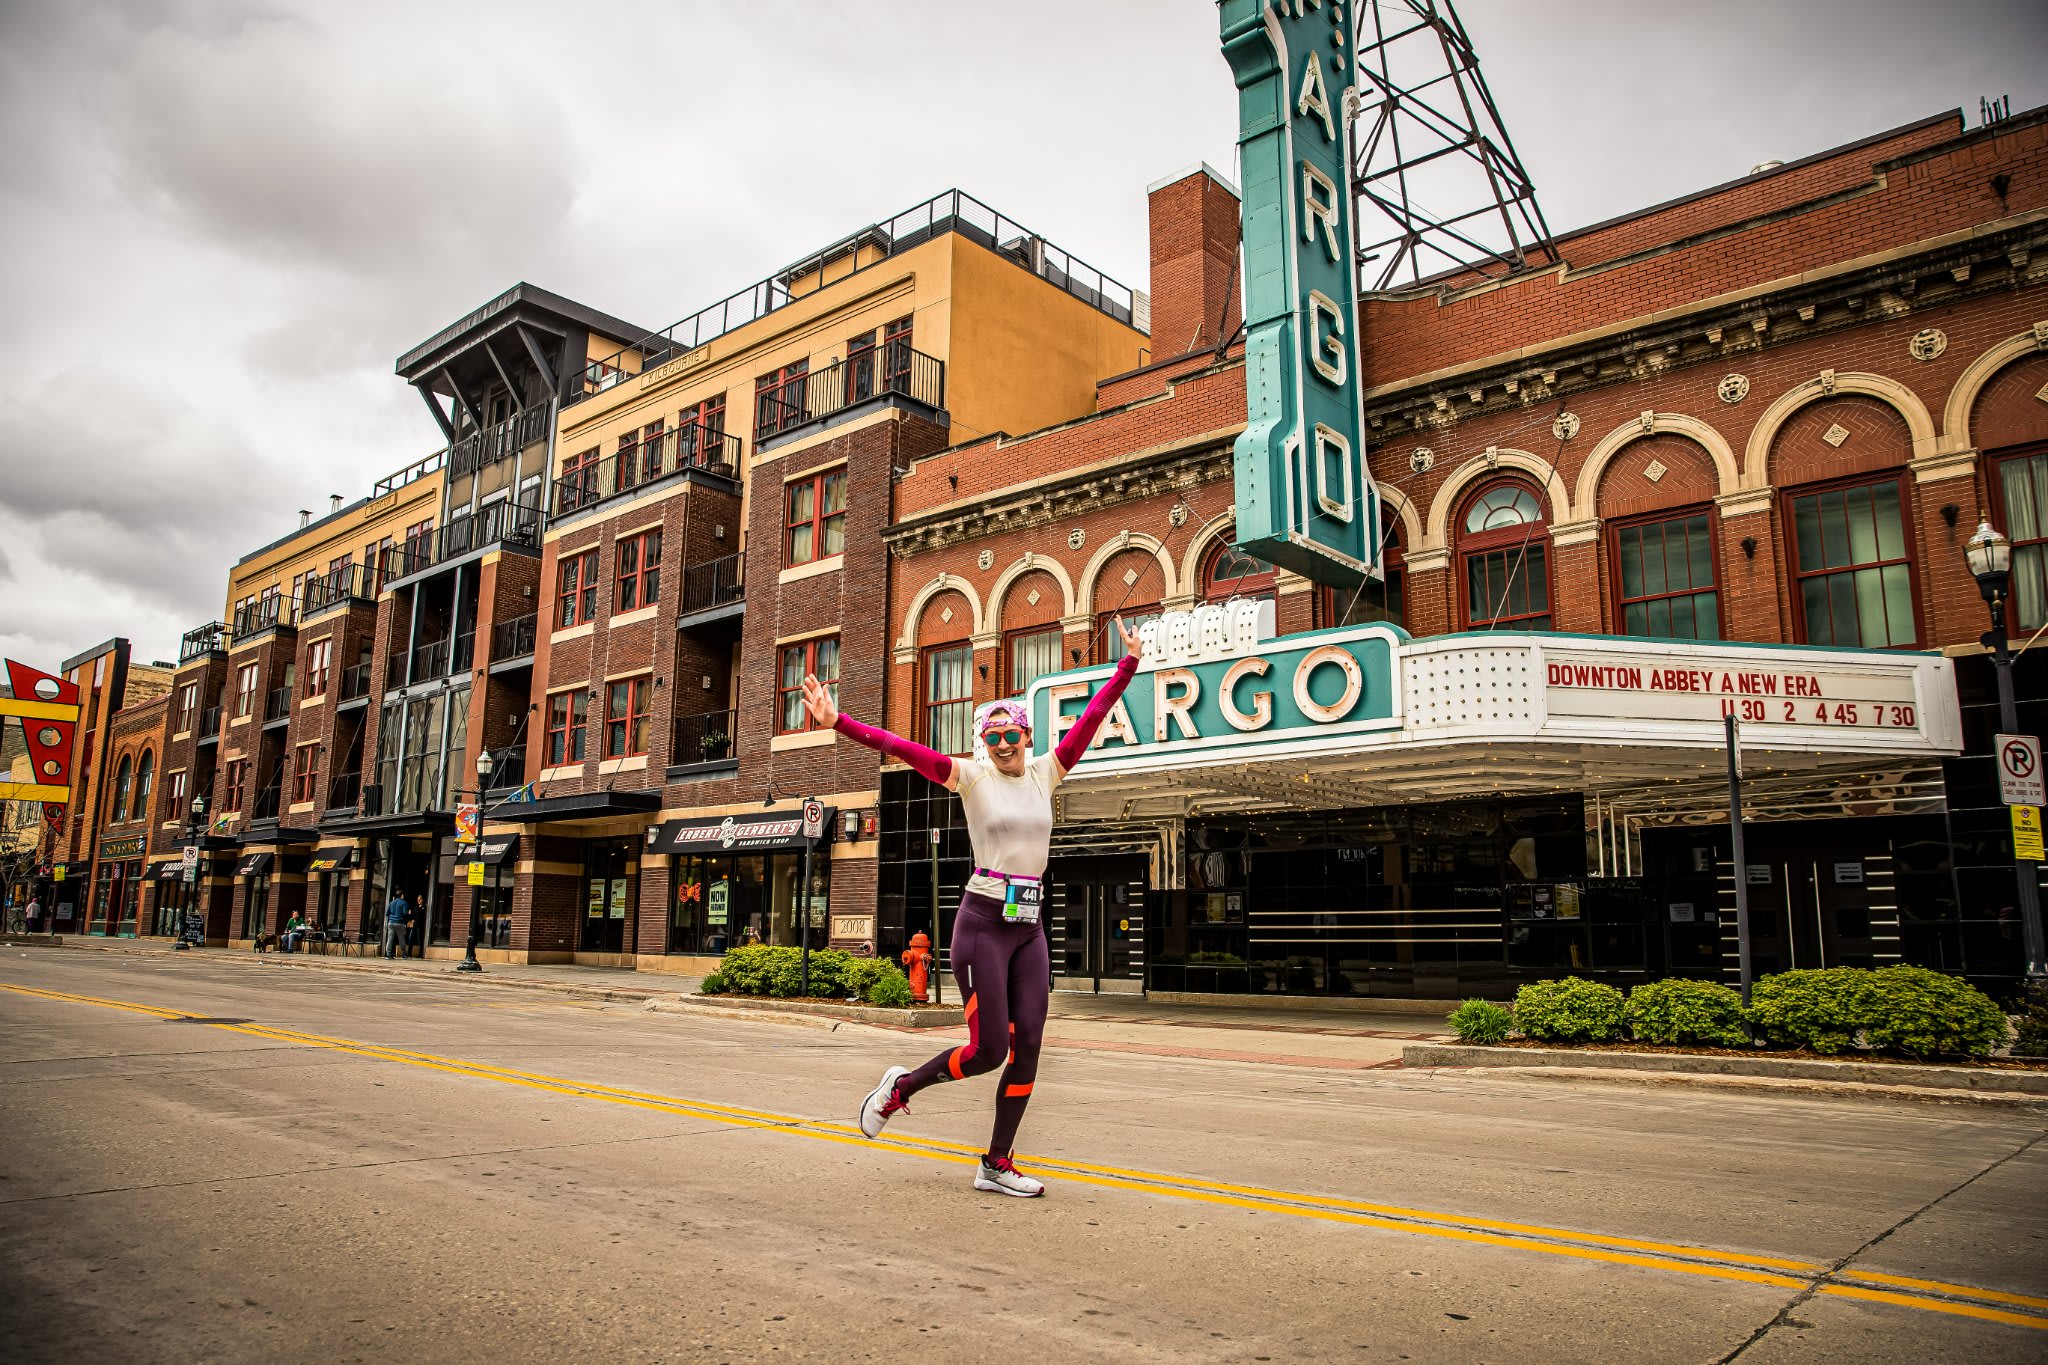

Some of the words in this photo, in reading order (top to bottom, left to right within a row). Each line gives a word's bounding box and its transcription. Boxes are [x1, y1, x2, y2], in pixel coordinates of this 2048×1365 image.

[1296, 0, 1354, 524] ARGO
[648, 351, 699, 383] KILBOURNE
[1548, 664, 1642, 689] DOWNTON
[1650, 669, 1713, 693] ABBEY
[1721, 672, 1734, 693] A
[1739, 673, 1777, 695] NEW
[1784, 675, 1822, 697] ERA
[1049, 645, 1363, 752] FARGO
[1741, 699, 1765, 721] 30
[1784, 701, 1796, 722] 2
[1815, 703, 1828, 723] 4
[1834, 704, 1858, 725] 45
[1873, 706, 1884, 726] 7
[1891, 706, 1915, 727] 30
[679, 828, 720, 840] ERBERT
[737, 822, 798, 837] GERBERT'S
[710, 890, 727, 902] NOW
[1022, 888, 1037, 901] 441
[840, 919, 865, 934] 2008
